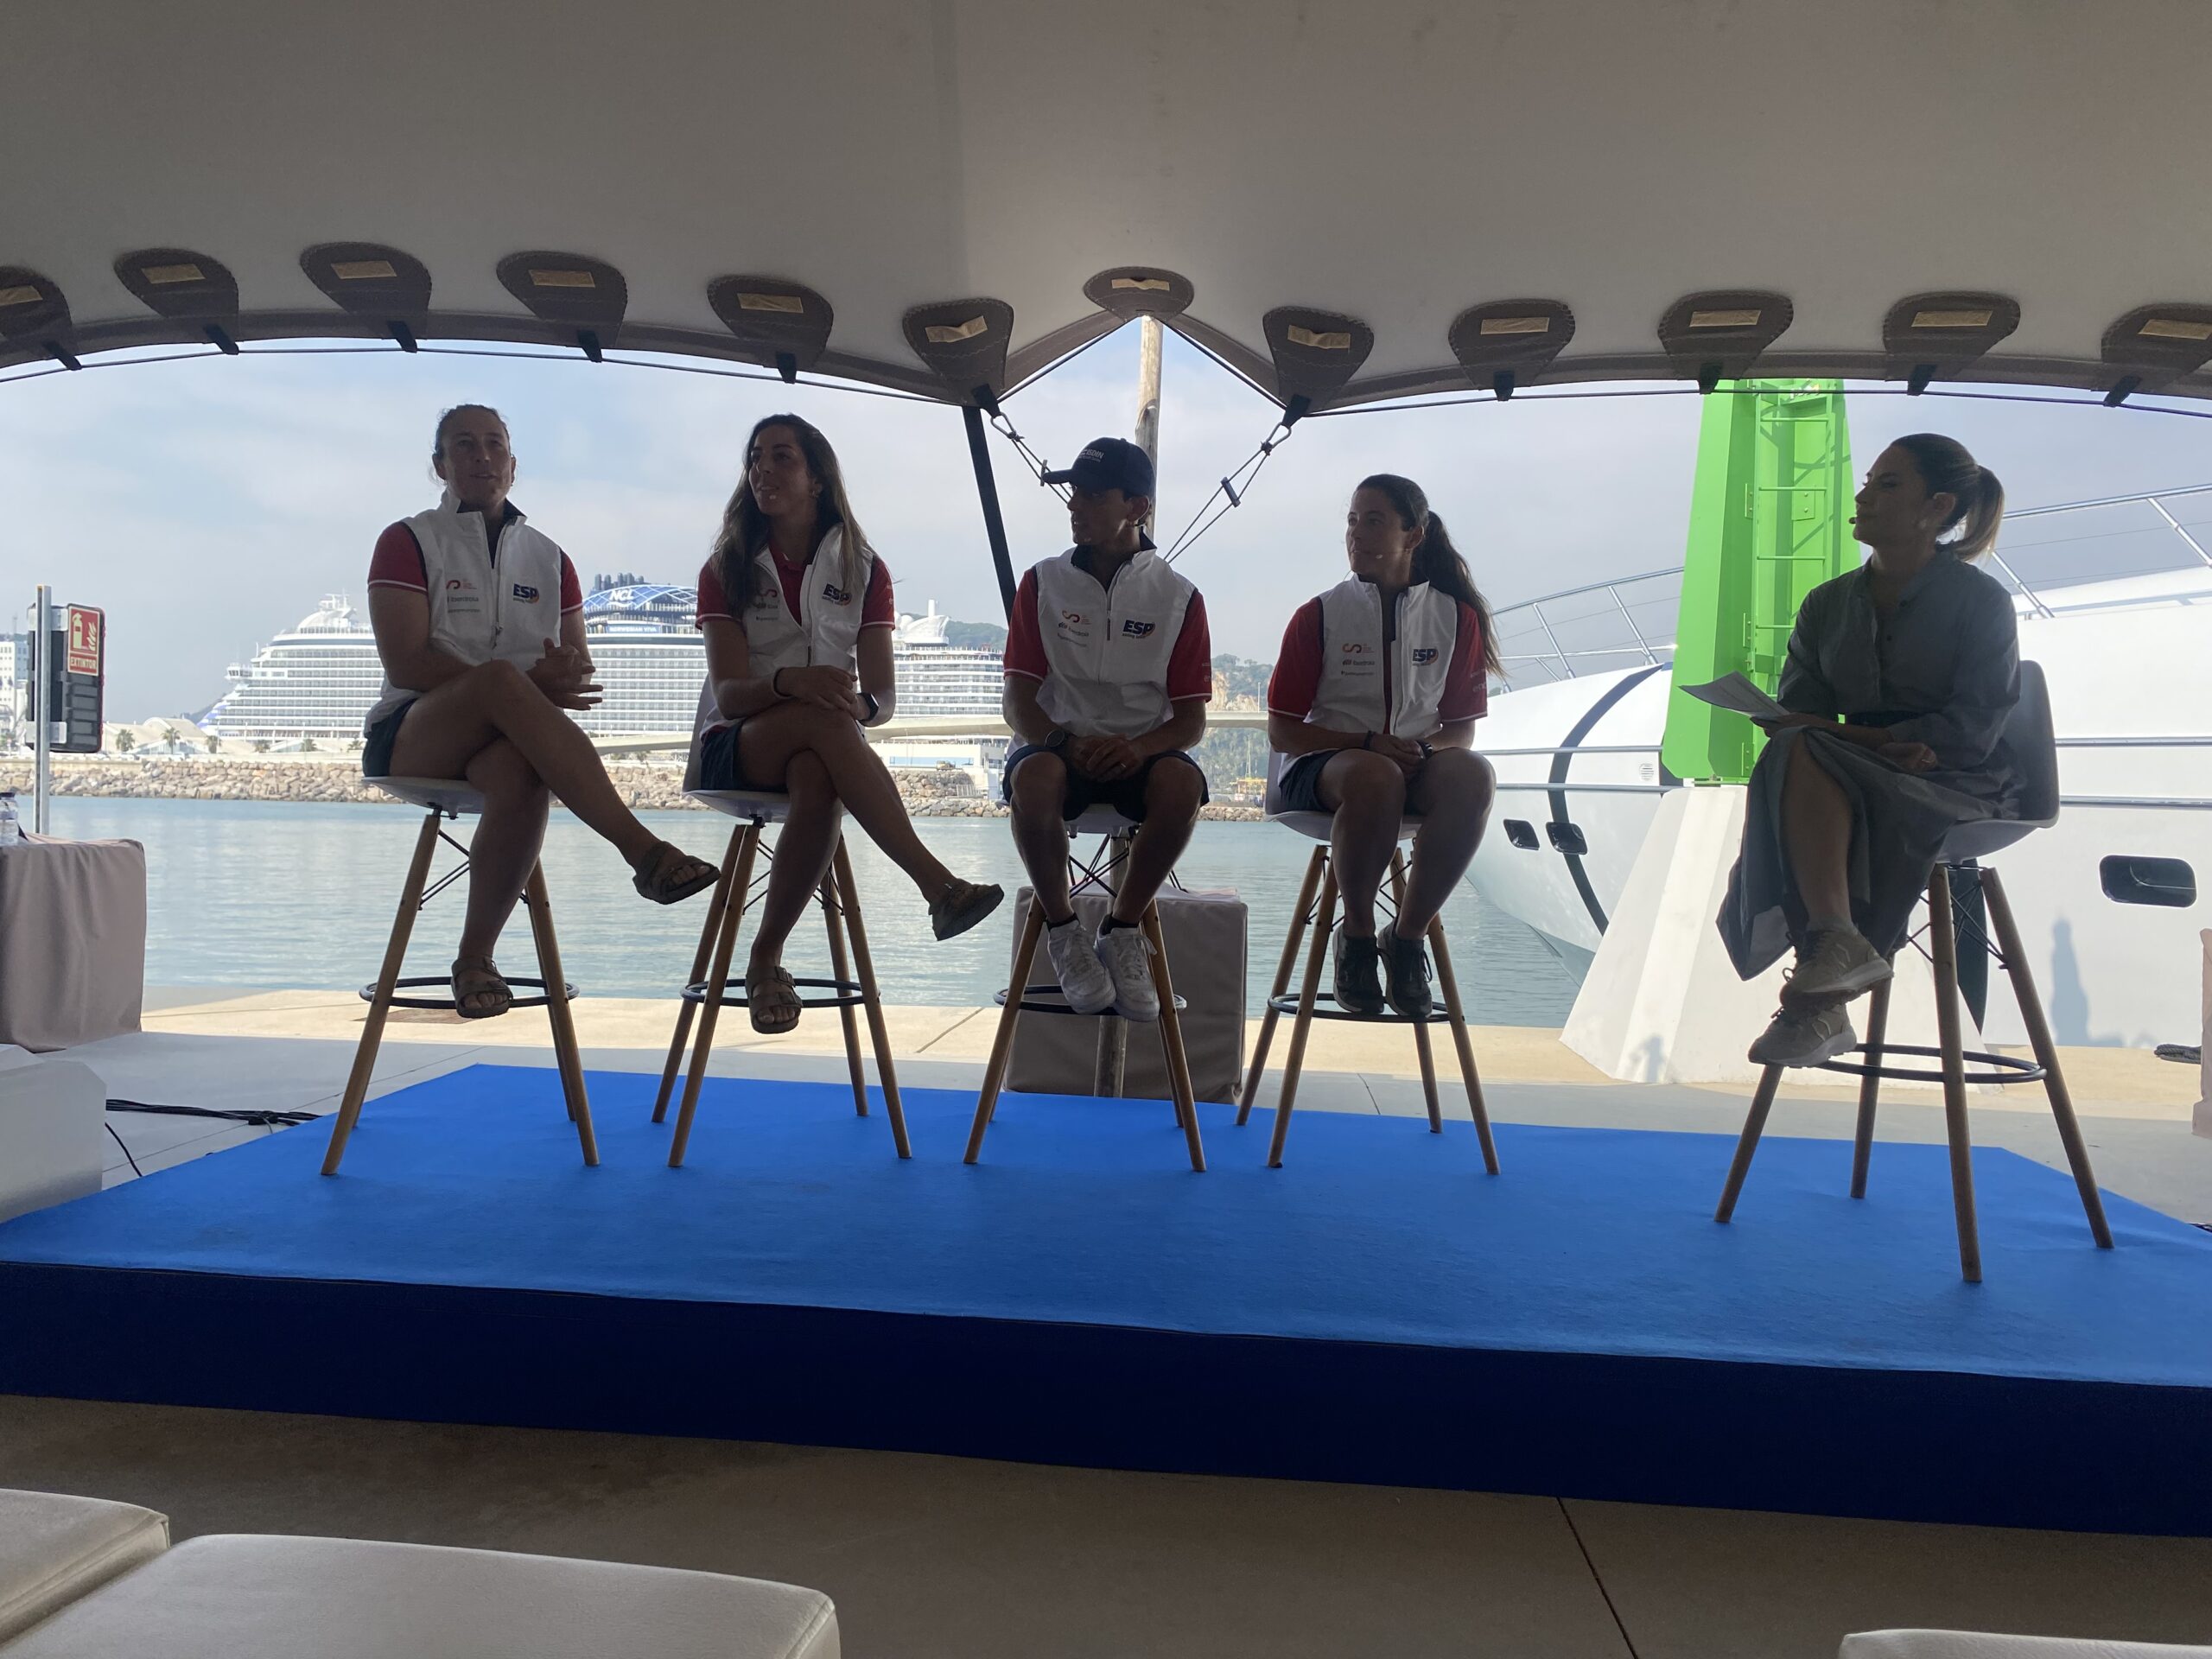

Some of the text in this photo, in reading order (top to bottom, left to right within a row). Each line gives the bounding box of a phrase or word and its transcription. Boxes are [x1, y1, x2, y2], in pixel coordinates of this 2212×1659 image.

[1086, 449, 1104, 459] ISDIN
[513, 584, 538, 599] ESP
[609, 588, 633, 601] NCL
[823, 583, 851, 602] ESP
[1122, 620, 1154, 635] ESP
[1413, 648, 1437, 662] ESP
